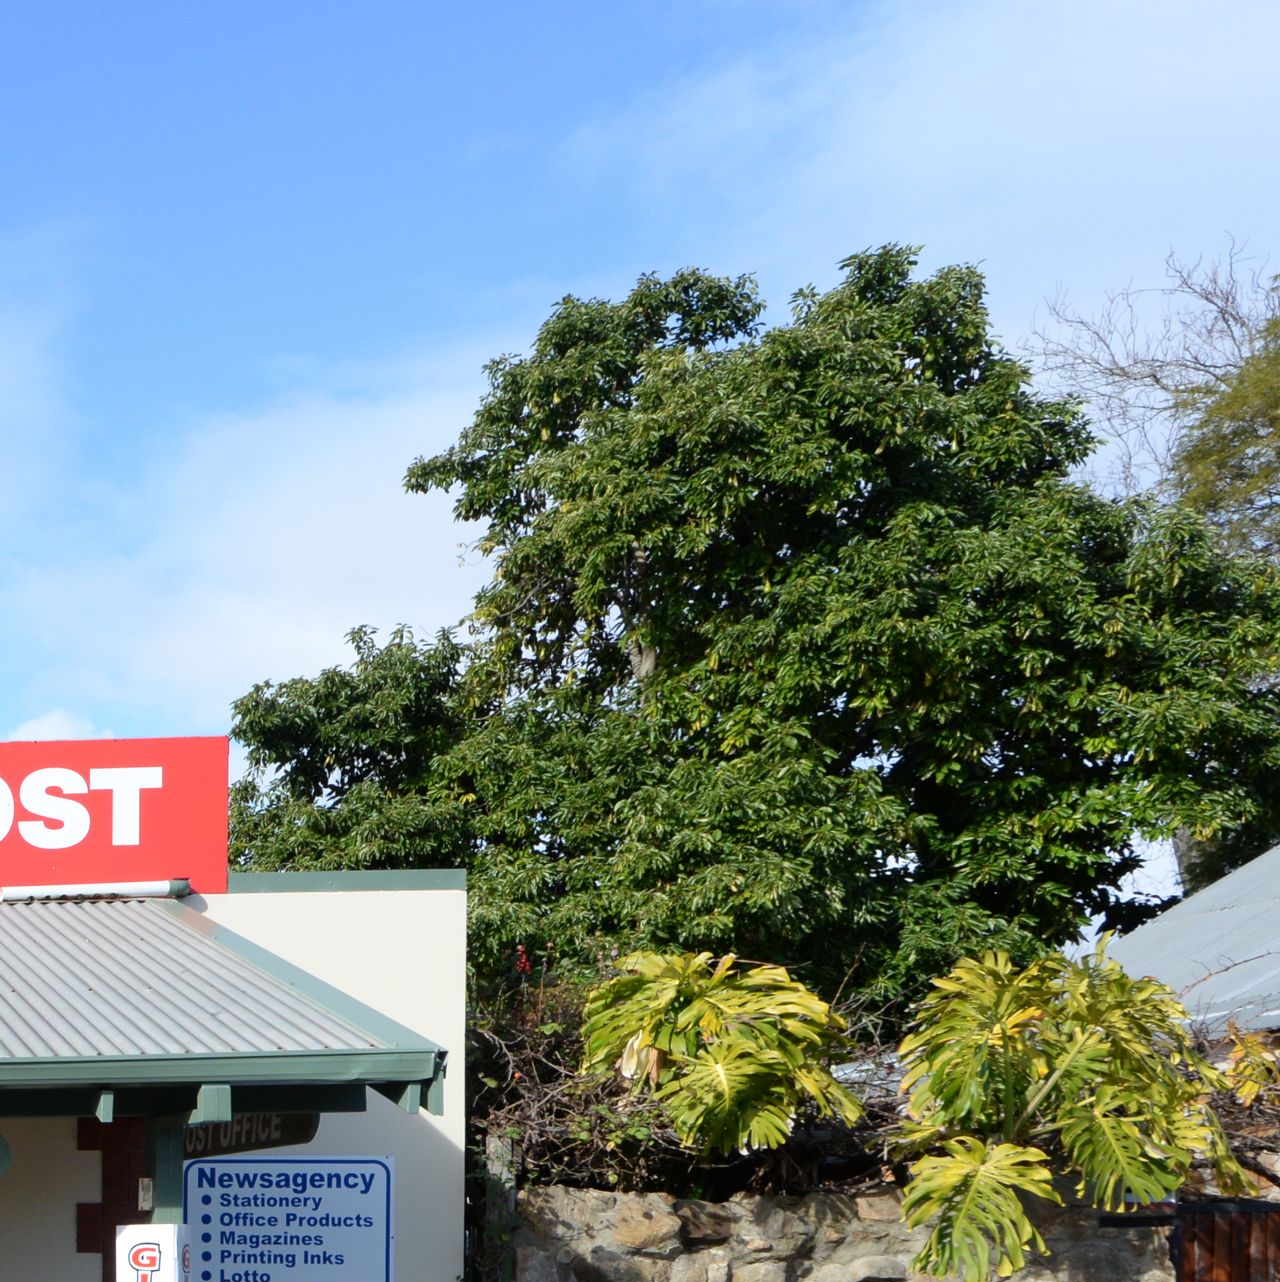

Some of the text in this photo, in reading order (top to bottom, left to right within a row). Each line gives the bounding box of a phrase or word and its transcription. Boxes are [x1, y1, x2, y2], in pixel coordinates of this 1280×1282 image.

[197, 1167, 376, 1195] Newsagency
[220, 1193, 322, 1211] Stationery
[220, 1212, 374, 1228] Office Products
[220, 1231, 324, 1249] Magazines
[220, 1250, 345, 1268] Printing Inks
[220, 1269, 271, 1282] Lotto
